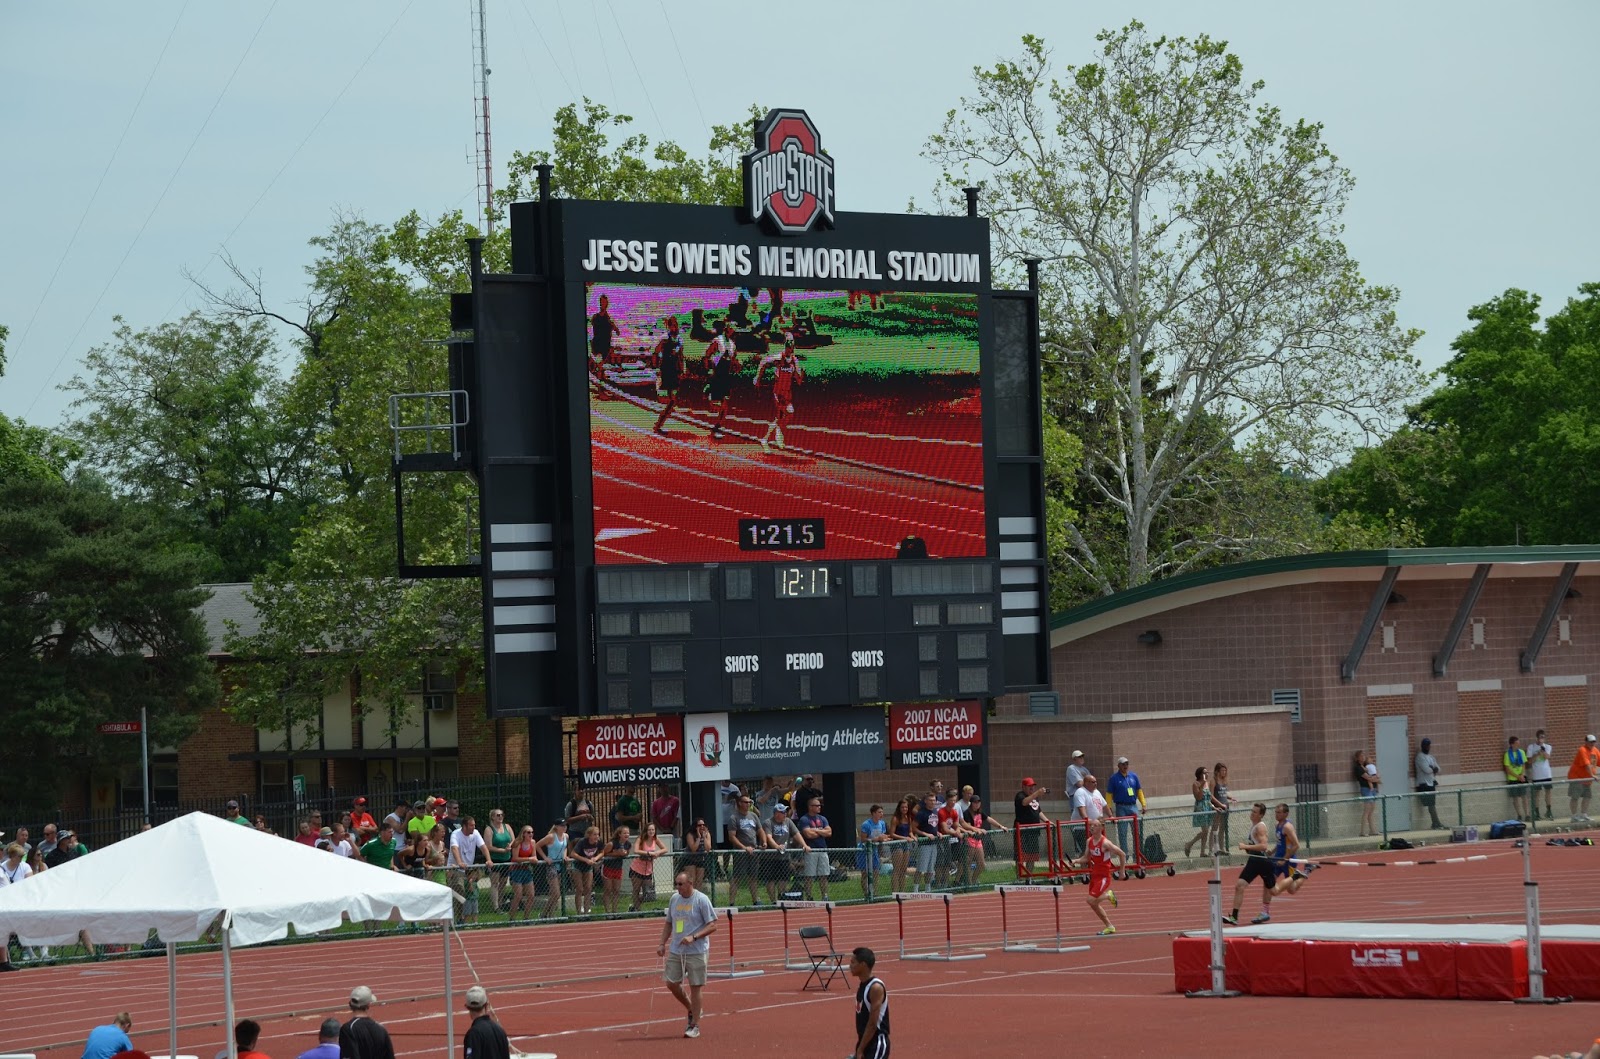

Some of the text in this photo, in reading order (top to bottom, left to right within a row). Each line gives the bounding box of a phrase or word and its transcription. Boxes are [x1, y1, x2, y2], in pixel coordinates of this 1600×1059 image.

[752, 144, 834, 222] OHIO STATE
[582, 239, 980, 283] JESSE OWENS MEMORIAL STADIUM
[748, 524, 815, 545] 1:21.5
[782, 567, 828, 596] 12:17
[725, 655, 759, 673] SHOTS
[786, 652, 824, 671] PERIOD
[851, 650, 884, 668] SHOTS
[904, 707, 968, 725] 2007 NCAA
[596, 722, 665, 741] 2010 NCAA
[734, 733, 782, 752] Athletes
[785, 730, 829, 752] Helping
[896, 723, 977, 742] COLLEGE CUP
[585, 740, 677, 760] COLLEGE CUP
[745, 751, 801, 760] ohiostatebuckeyes.com
[902, 748, 973, 765] MEN'S SOCCER
[583, 766, 680, 784] WOMEN'S SOCCER
[1351, 949, 1402, 963] UCS
